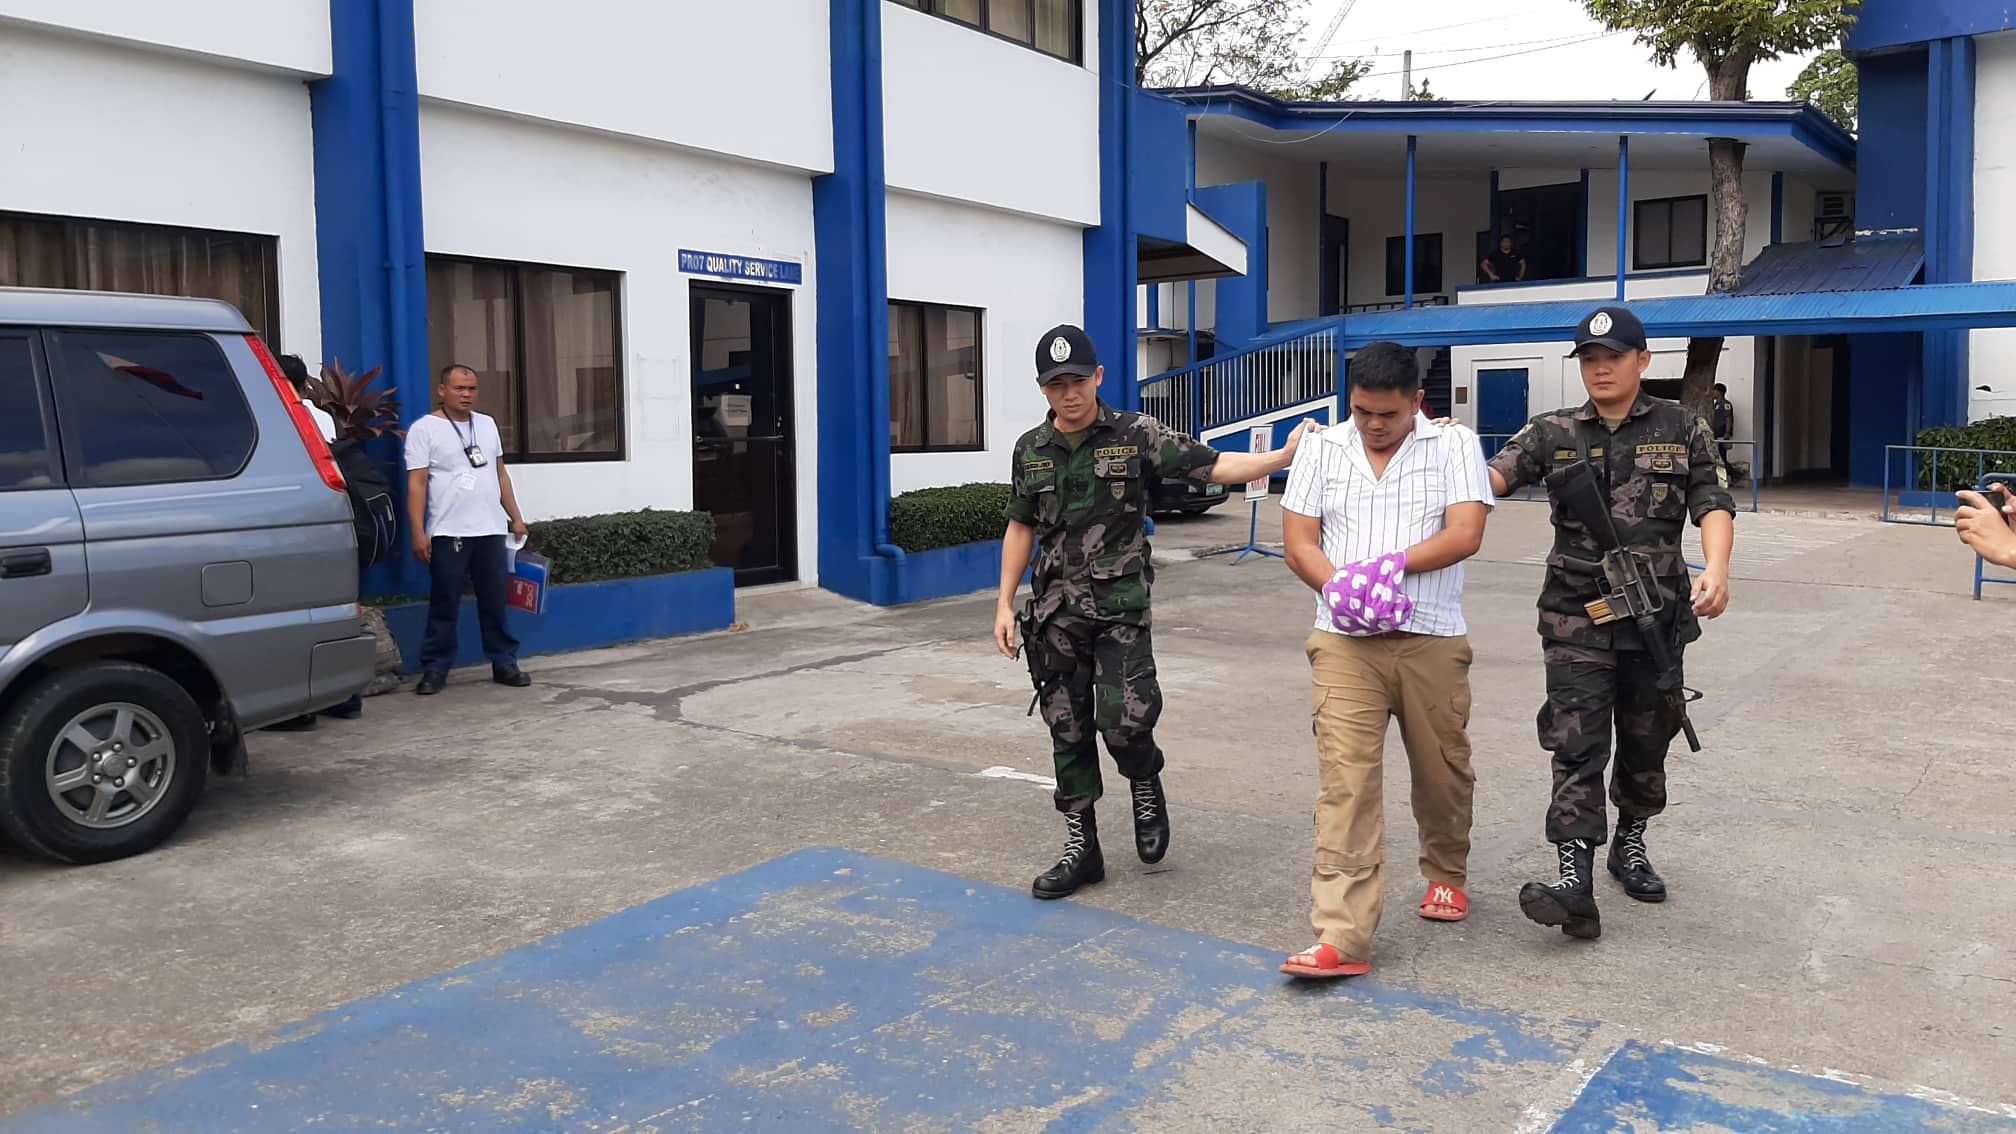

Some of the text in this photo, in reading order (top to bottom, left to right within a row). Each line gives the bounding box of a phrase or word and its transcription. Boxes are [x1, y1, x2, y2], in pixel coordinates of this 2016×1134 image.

[707, 256, 743, 274] QUALITY
[745, 260, 778, 278] SERVICE
[1095, 446, 1136, 457] POLICE
[1639, 445, 1682, 453] POLICE
